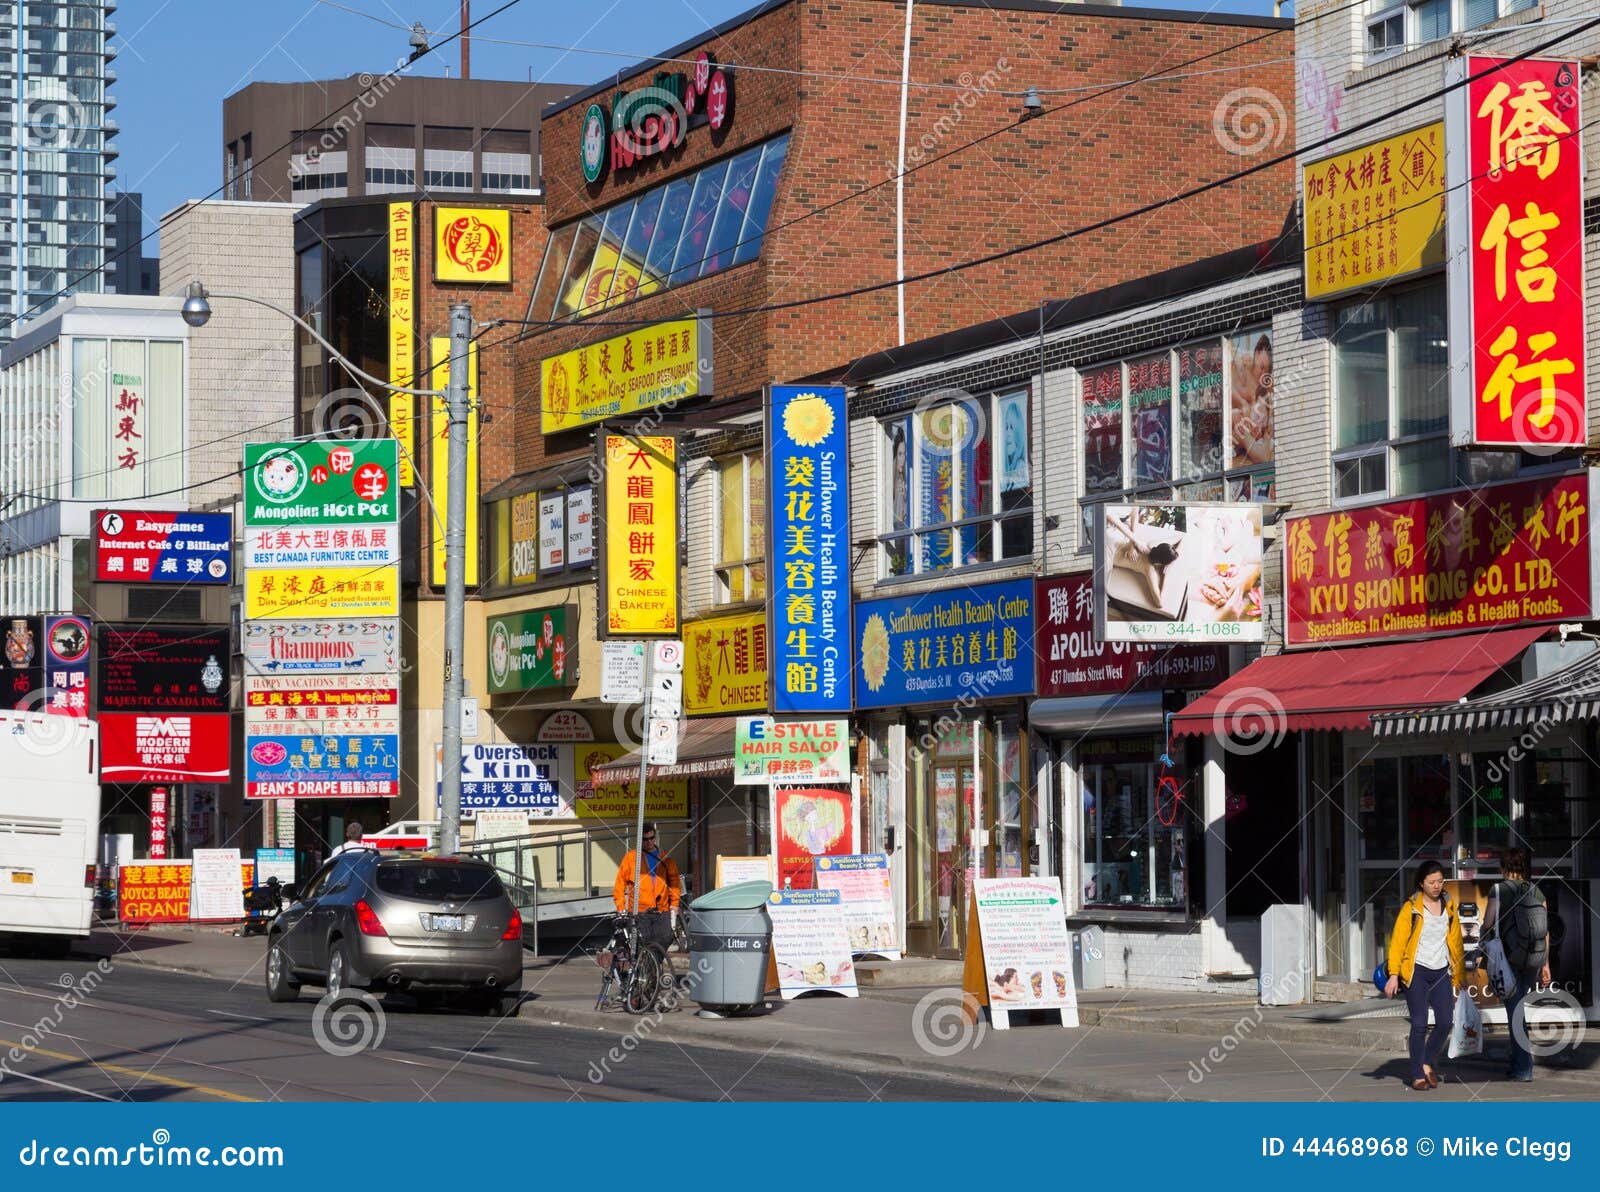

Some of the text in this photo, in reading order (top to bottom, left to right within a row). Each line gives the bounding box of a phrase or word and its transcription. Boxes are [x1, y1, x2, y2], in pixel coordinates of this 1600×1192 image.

[1308, 147, 1393, 201] 加拿大特產
[1477, 81, 1577, 430] 僑信行
[396, 331, 407, 361] ALL
[643, 329, 691, 366] 海鮮酒家
[575, 388, 590, 407] Dim
[608, 378, 626, 399] King
[628, 374, 655, 392] SEAFOOD
[115, 389, 143, 470] 新東方
[396, 409, 407, 441] DIM
[311, 450, 385, 500] 小肥羊
[254, 505, 319, 520] Mongolian
[627, 448, 655, 580] 大龍鳳餅家
[136, 520, 204, 534] Easygames
[100, 539, 229, 551] Internet Cafe & Billiard
[257, 528, 387, 549] 北美大型傢俬展
[254, 550, 389, 563] BEST CANADA FURNITURE CENTRE
[107, 557, 203, 574] 網吧桌球
[784, 456, 817, 693] 葵花美容養生館
[819, 452, 839, 699] Sunflower Health Beauty Centre
[332, 580, 385, 593] 海鮮酒家
[617, 587, 667, 597] CHINESE
[1309, 558, 1558, 615] KYU SHON HONG CO. LTD.
[304, 595, 327, 608] King
[619, 600, 665, 610] BAKERY
[889, 595, 1029, 634] Sunflower Health Beauty Centre
[1307, 594, 1563, 640] Specializes In Chinese Herbs & Health Foods.
[1166, 623, 1241, 636] 344-1086
[270, 636, 355, 662] Champions
[902, 626, 1017, 672] 葵花美容養生館
[1051, 630, 1105, 661] APOLLO
[1154, 655, 1216, 675] 416-593-0159
[53, 671, 85, 688] 网吧
[1051, 664, 1123, 684] 437 Dundas Street West
[253, 678, 335, 689] HAPPY VACATIONS
[916, 676, 938, 690] Dundas
[53, 691, 85, 708] 桌球
[104, 695, 152, 707] MAJESTIC
[156, 696, 199, 706] CANADA
[720, 684, 761, 706] CHINESE
[555, 714, 577, 725] 421
[137, 738, 190, 747] MODERN
[742, 743, 783, 754] HAIR
[474, 744, 559, 760] Overstock
[483, 761, 550, 780] King
[254, 781, 337, 795] JEAN'S DRAPE
[623, 786, 646, 799] Su
[506, 793, 560, 805] Outlet
[630, 803, 684, 812] RETAURANT
[122, 887, 156, 900] JOYCE
[125, 902, 190, 918] GRAND
[727, 938, 748, 949] Litter
